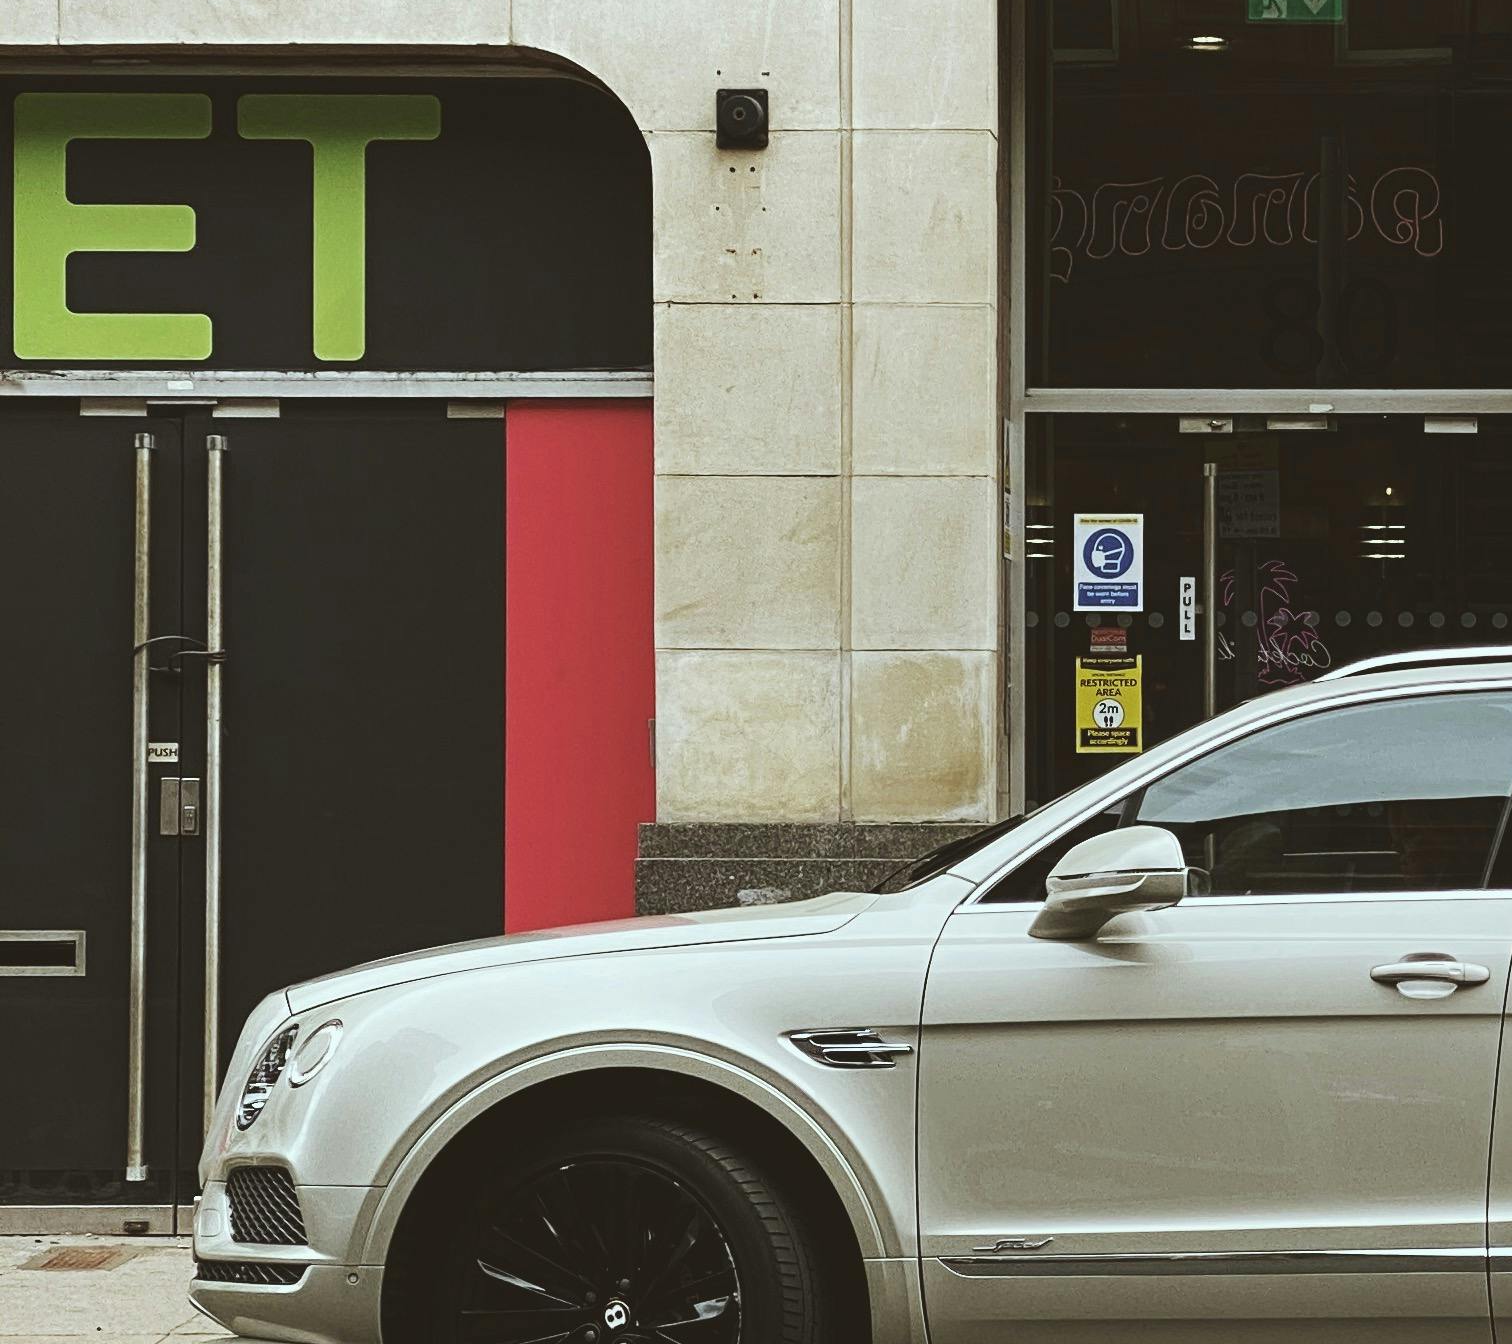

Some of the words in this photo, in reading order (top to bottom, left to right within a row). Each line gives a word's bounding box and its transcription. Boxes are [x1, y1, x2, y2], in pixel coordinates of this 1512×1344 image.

[13, 92, 443, 362] ET
[1183, 583, 1192, 634] PULL
[1080, 679, 1137, 688] RESTRICTED
[1096, 688, 1122, 697] AREA
[1099, 702, 1119, 714] 2m
[1087, 729, 1110, 737] Please
[1110, 730, 1131, 739] space
[148, 747, 179, 758] PUSH
